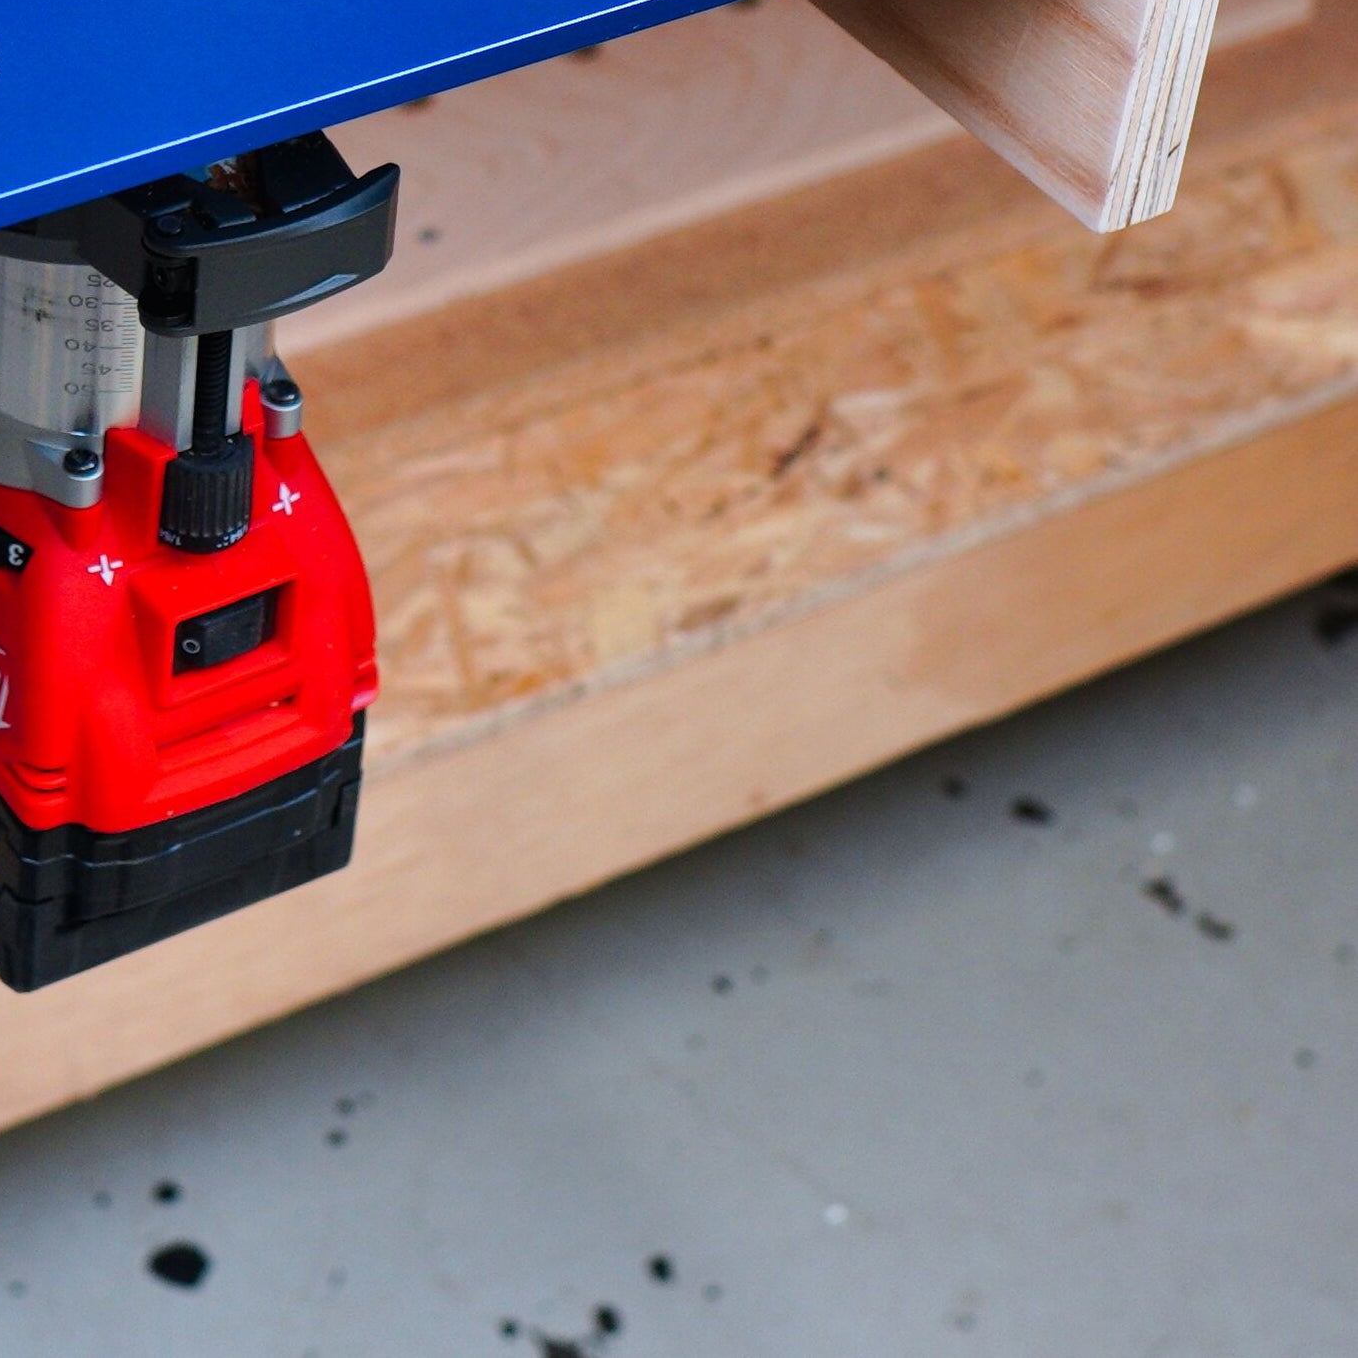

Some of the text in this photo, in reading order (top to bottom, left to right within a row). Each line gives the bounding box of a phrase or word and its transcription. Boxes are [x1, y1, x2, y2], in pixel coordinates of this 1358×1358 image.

[68, 294, 99, 309] 30
[84, 318, 113, 332] 35
[65, 338, 97, 353] 40
[82, 362, 111, 375] 45
[8, 543, 25, 566] 3
